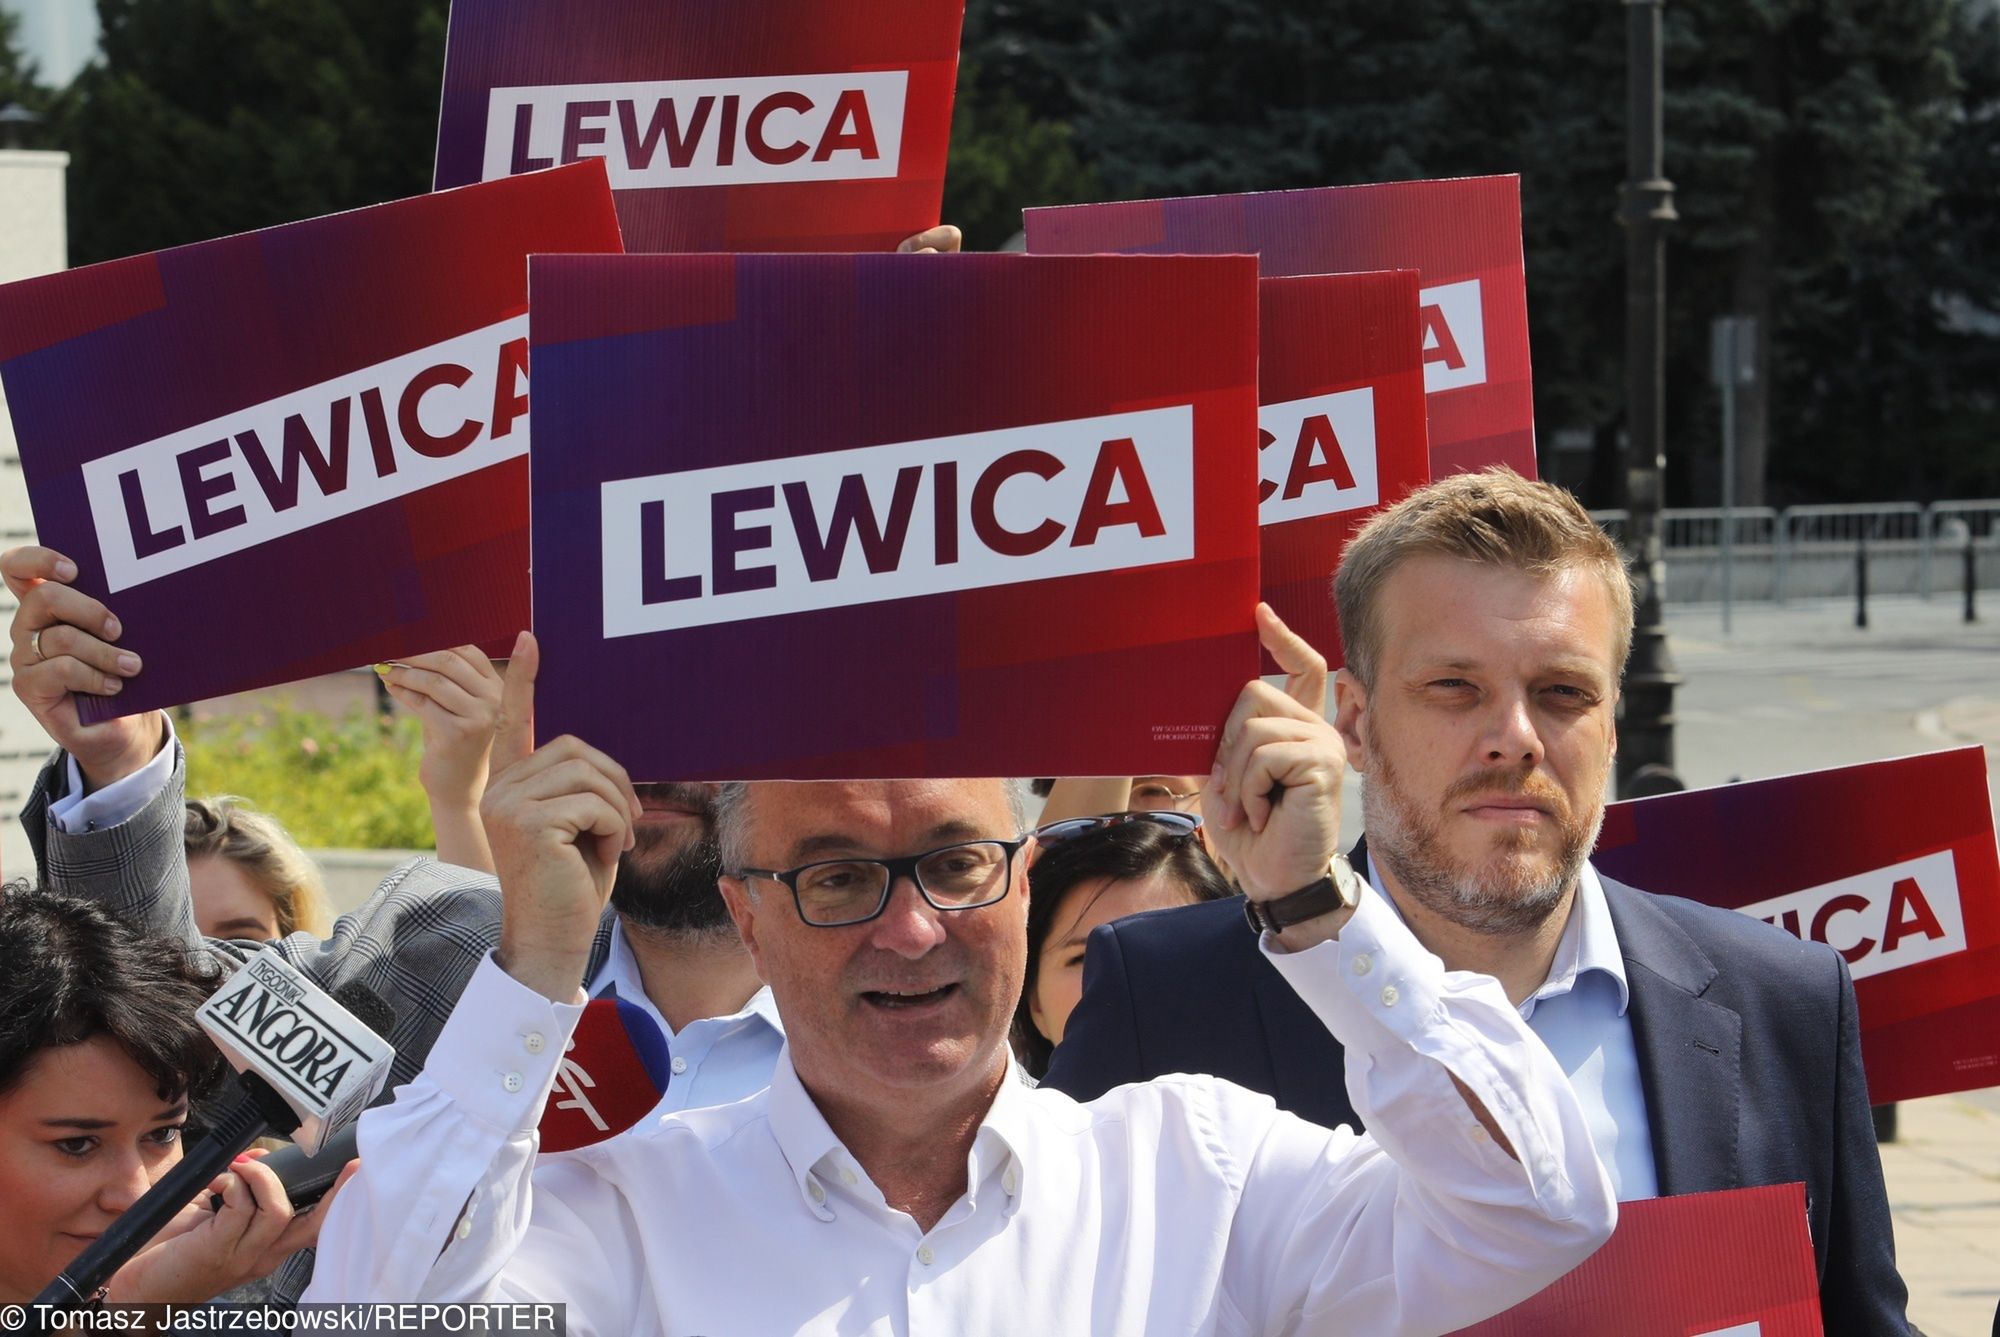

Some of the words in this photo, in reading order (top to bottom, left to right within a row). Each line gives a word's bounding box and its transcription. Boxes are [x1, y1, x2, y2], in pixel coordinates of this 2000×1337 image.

[510, 89, 880, 175] LEWICA
[641, 437, 1167, 605] LEWICA
[252, 963, 303, 1004] TYGODNIK
[213, 982, 353, 1100] ANGORA
